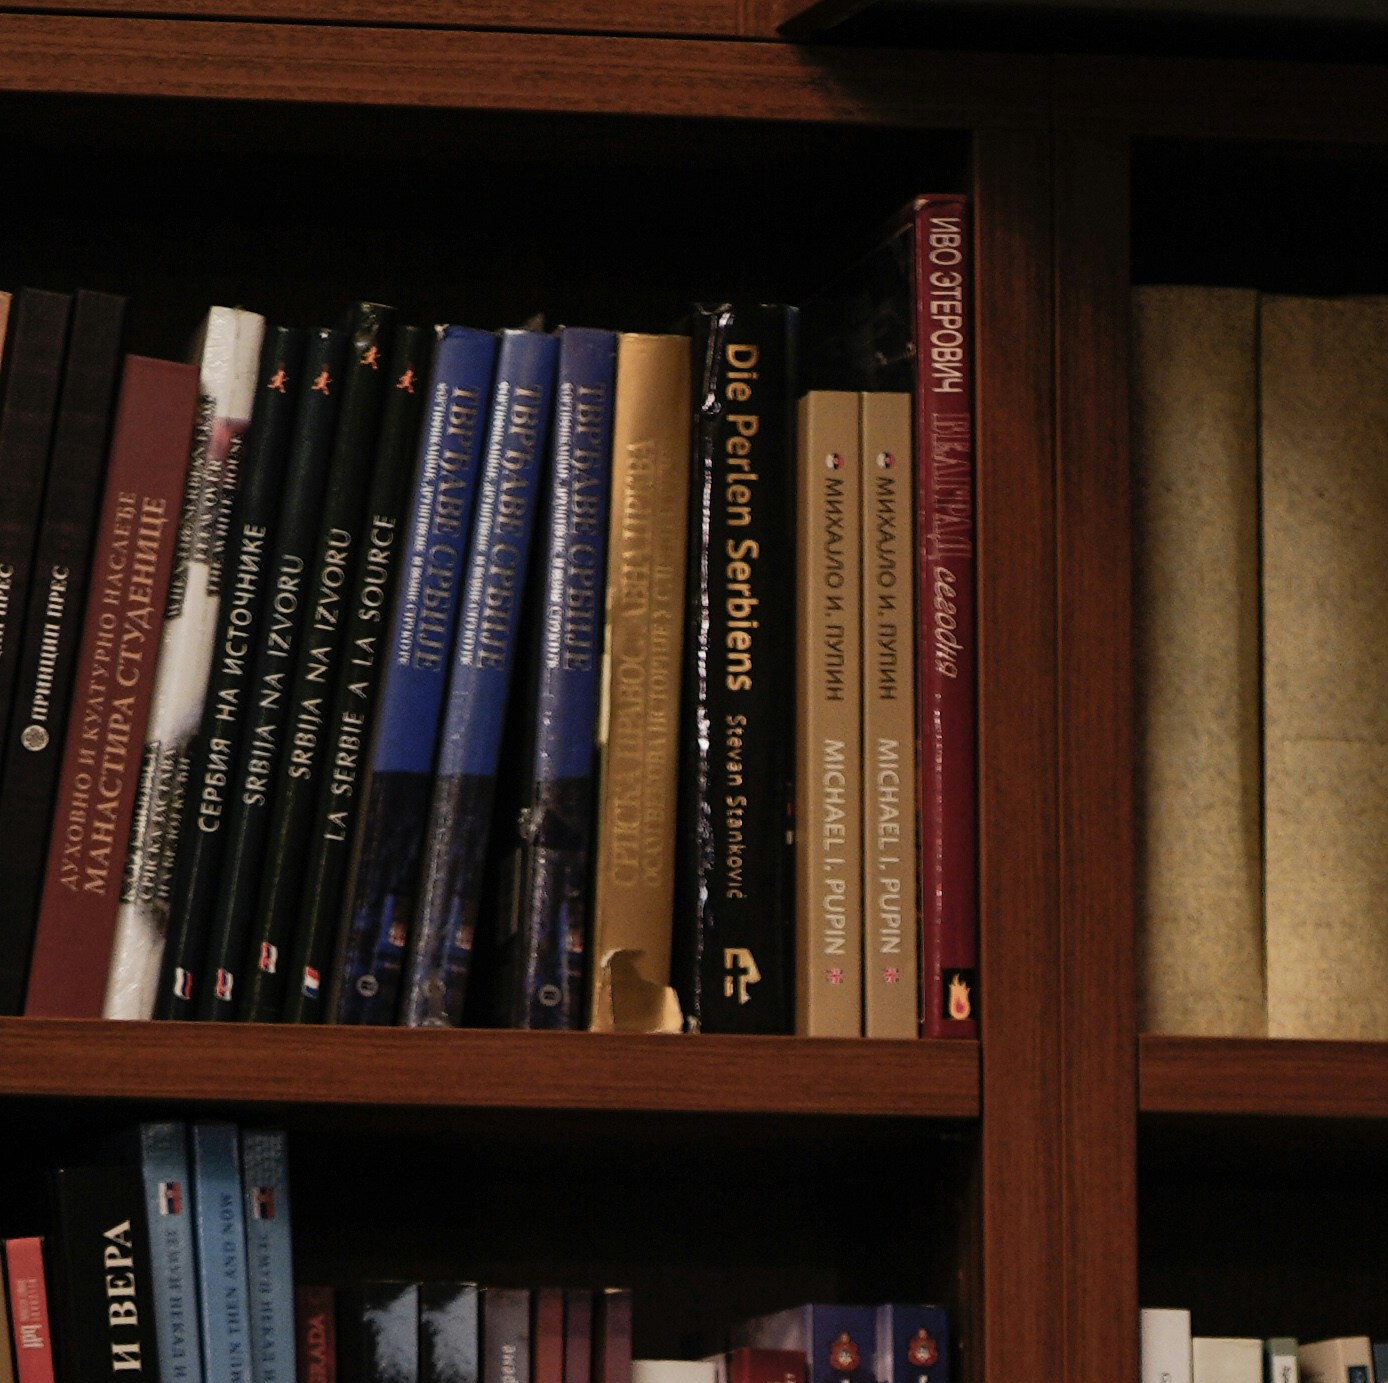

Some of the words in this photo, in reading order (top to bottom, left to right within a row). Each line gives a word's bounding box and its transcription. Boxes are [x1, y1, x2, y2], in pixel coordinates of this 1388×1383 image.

[929, 217, 962, 266] ИВО
[725, 343, 760, 402] Die
[930, 270, 963, 393] ЭТЕРОВИЧ
[725, 413, 760, 527] Perlen
[314, 527, 351, 632] IZVORU
[358, 515, 396, 622] SOURCE
[825, 477, 844, 589] МИХАЈЛО
[876, 476, 896, 588] МИХАЈЛО
[30, 623, 60, 721] ПРИНЦИП
[46, 565, 71, 618] ПРЕС
[222, 524, 267, 675] ИСТОЧНИКЕ
[266, 553, 304, 657] IZVORU
[725, 538, 760, 692] Serbiens
[933, 566, 964, 679] сегодня
[60, 774, 94, 892] ДУХОВНО
[85, 613, 118, 740] КУЛТУРНО
[105, 491, 137, 606] НАСЛЕЂЕ
[85, 695, 136, 895] МАНАСТИРА
[116, 496, 167, 688] СТУДЕНИЦЕ
[260, 673, 286, 709] NA
[306, 646, 333, 683] NA
[352, 637, 376, 666] LA
[826, 623, 845, 701] ПУПИН
[879, 622, 898, 700] ПУПИН
[215, 688, 240, 720] НА
[288, 699, 323, 779] SRBIJA
[330, 711, 365, 796] SERBIE
[725, 713, 748, 787] Stevan
[198, 737, 232, 833] СЕРБИЯ
[243, 725, 277, 806] SRBIJA
[824, 739, 846, 852] MICHAEL
[878, 738, 900, 851] MICHAEL
[323, 812, 348, 841] LA
[725, 794, 749, 900] Stanković
[824, 879, 846, 955] PUPIN
[879, 878, 901, 954] PUPIN
[102, 1220, 140, 1327] ВЕРА
[112, 1340, 141, 1373] И
